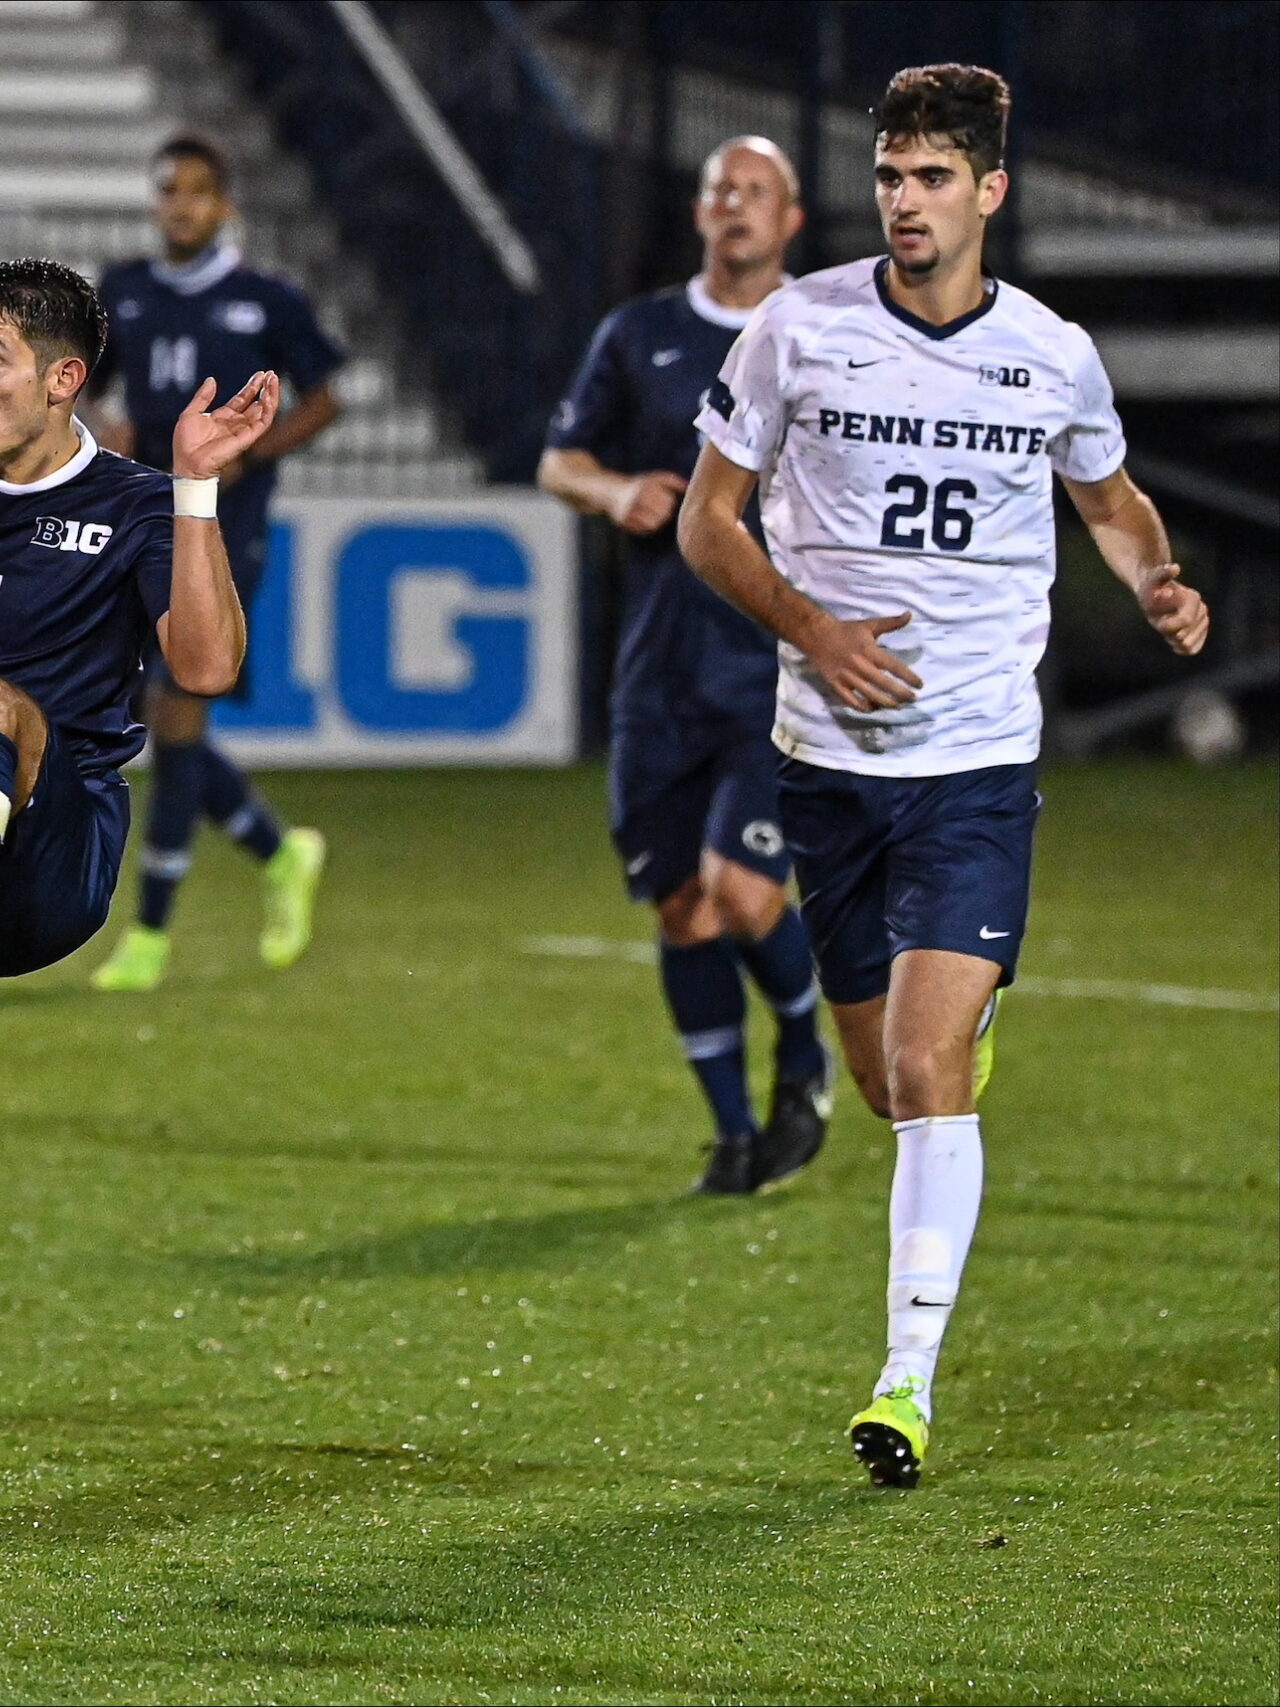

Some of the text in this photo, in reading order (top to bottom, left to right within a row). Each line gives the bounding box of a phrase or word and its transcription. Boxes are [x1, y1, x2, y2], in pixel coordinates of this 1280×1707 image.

[818, 408, 1047, 455] PENN STATE
[880, 473, 978, 552] 26
